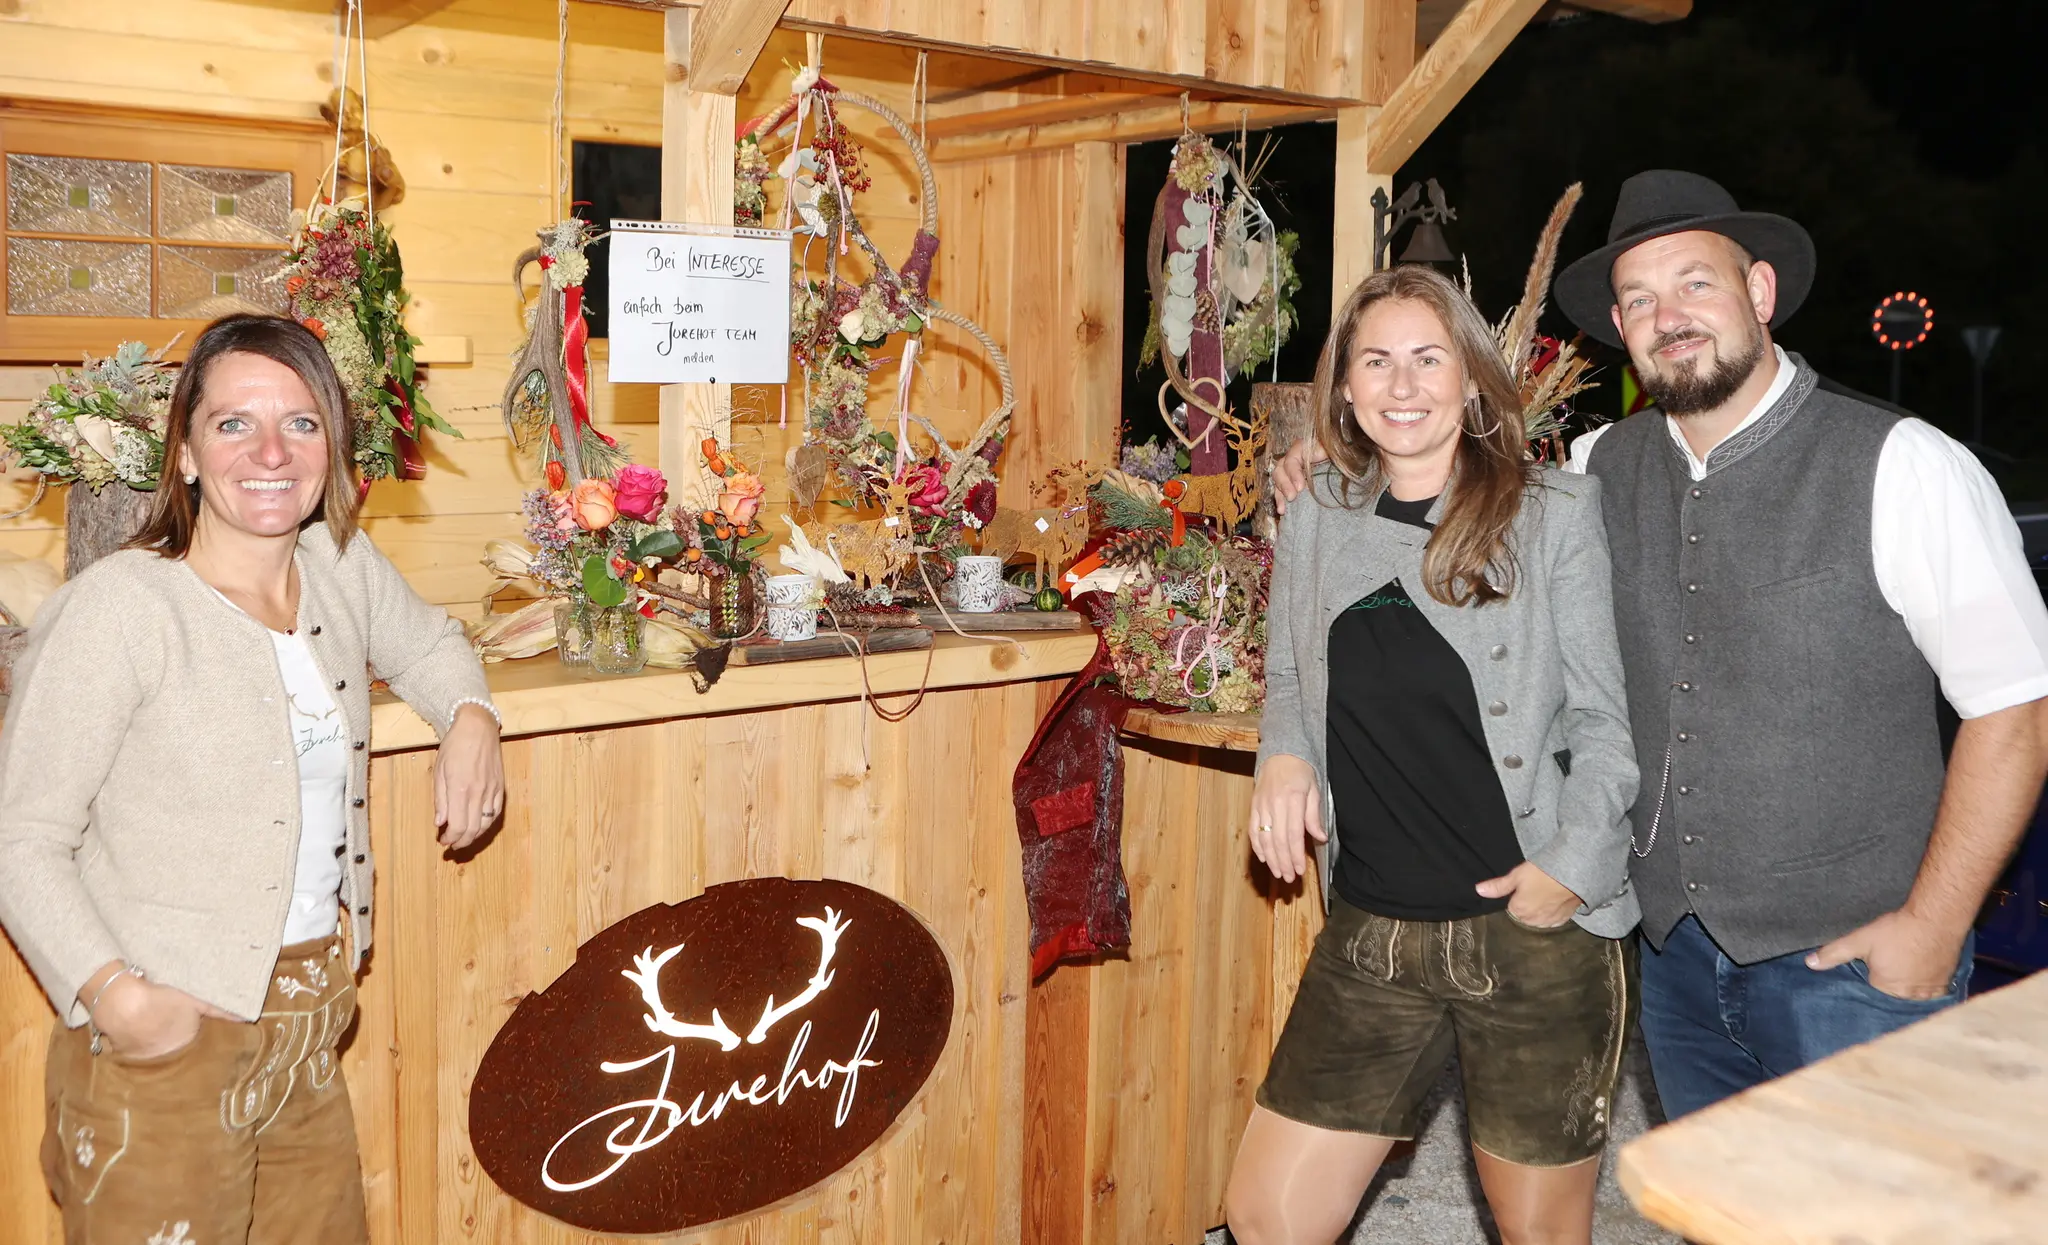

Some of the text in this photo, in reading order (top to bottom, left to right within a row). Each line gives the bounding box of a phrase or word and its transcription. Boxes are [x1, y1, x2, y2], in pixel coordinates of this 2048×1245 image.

[646, 246, 765, 279] Bei INTERESSE
[623, 296, 704, 317] einfach beim
[725, 328, 757, 341] TEAM
[683, 351, 715, 364] melden
[541, 1007, 884, 1192] Jurehof
